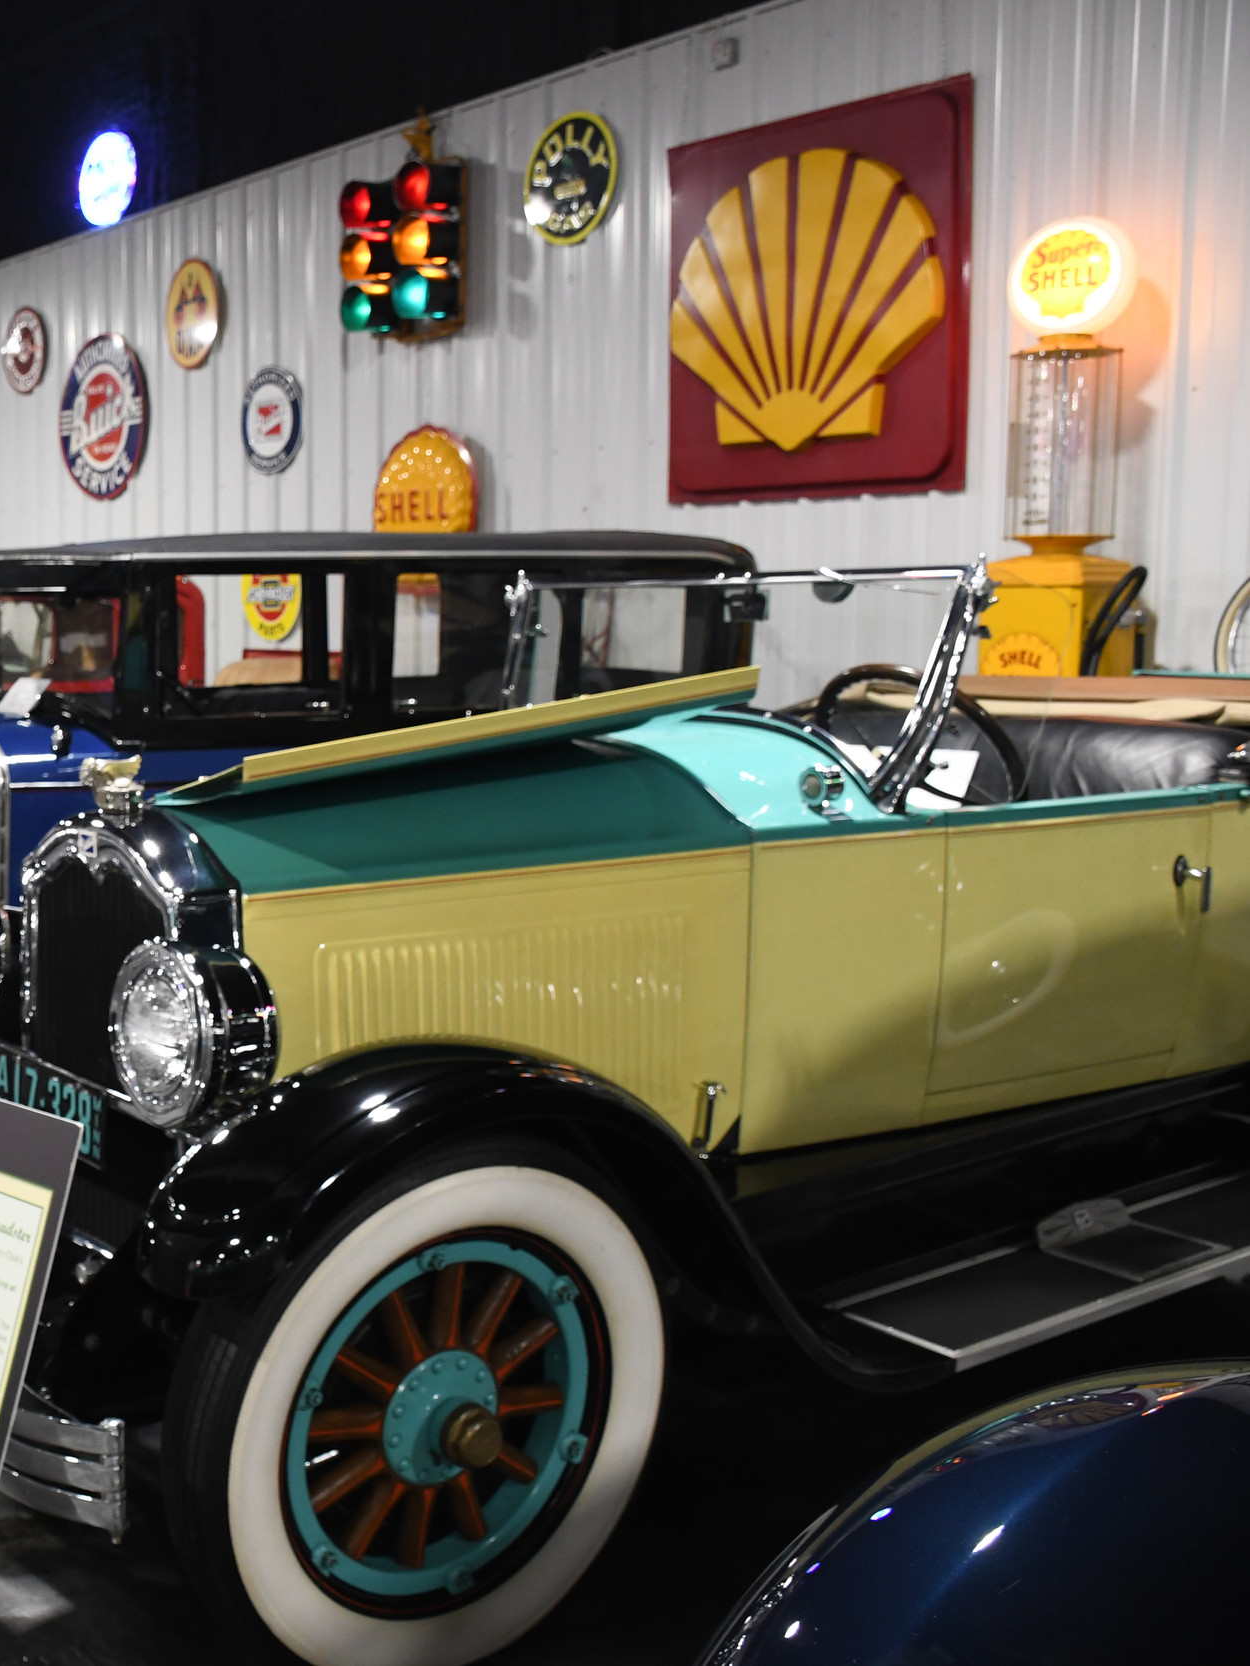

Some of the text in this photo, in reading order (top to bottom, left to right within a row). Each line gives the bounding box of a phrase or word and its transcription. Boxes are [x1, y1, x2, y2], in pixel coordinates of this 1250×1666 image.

[531, 123, 610, 188] POLLY
[1031, 240, 1103, 270] Super
[1029, 265, 1098, 292] SHELL
[71, 450, 133, 495] SERVICE
[375, 490, 450, 524] SHELL
[258, 621, 285, 638] PARTS
[999, 650, 1043, 670] SHELL
